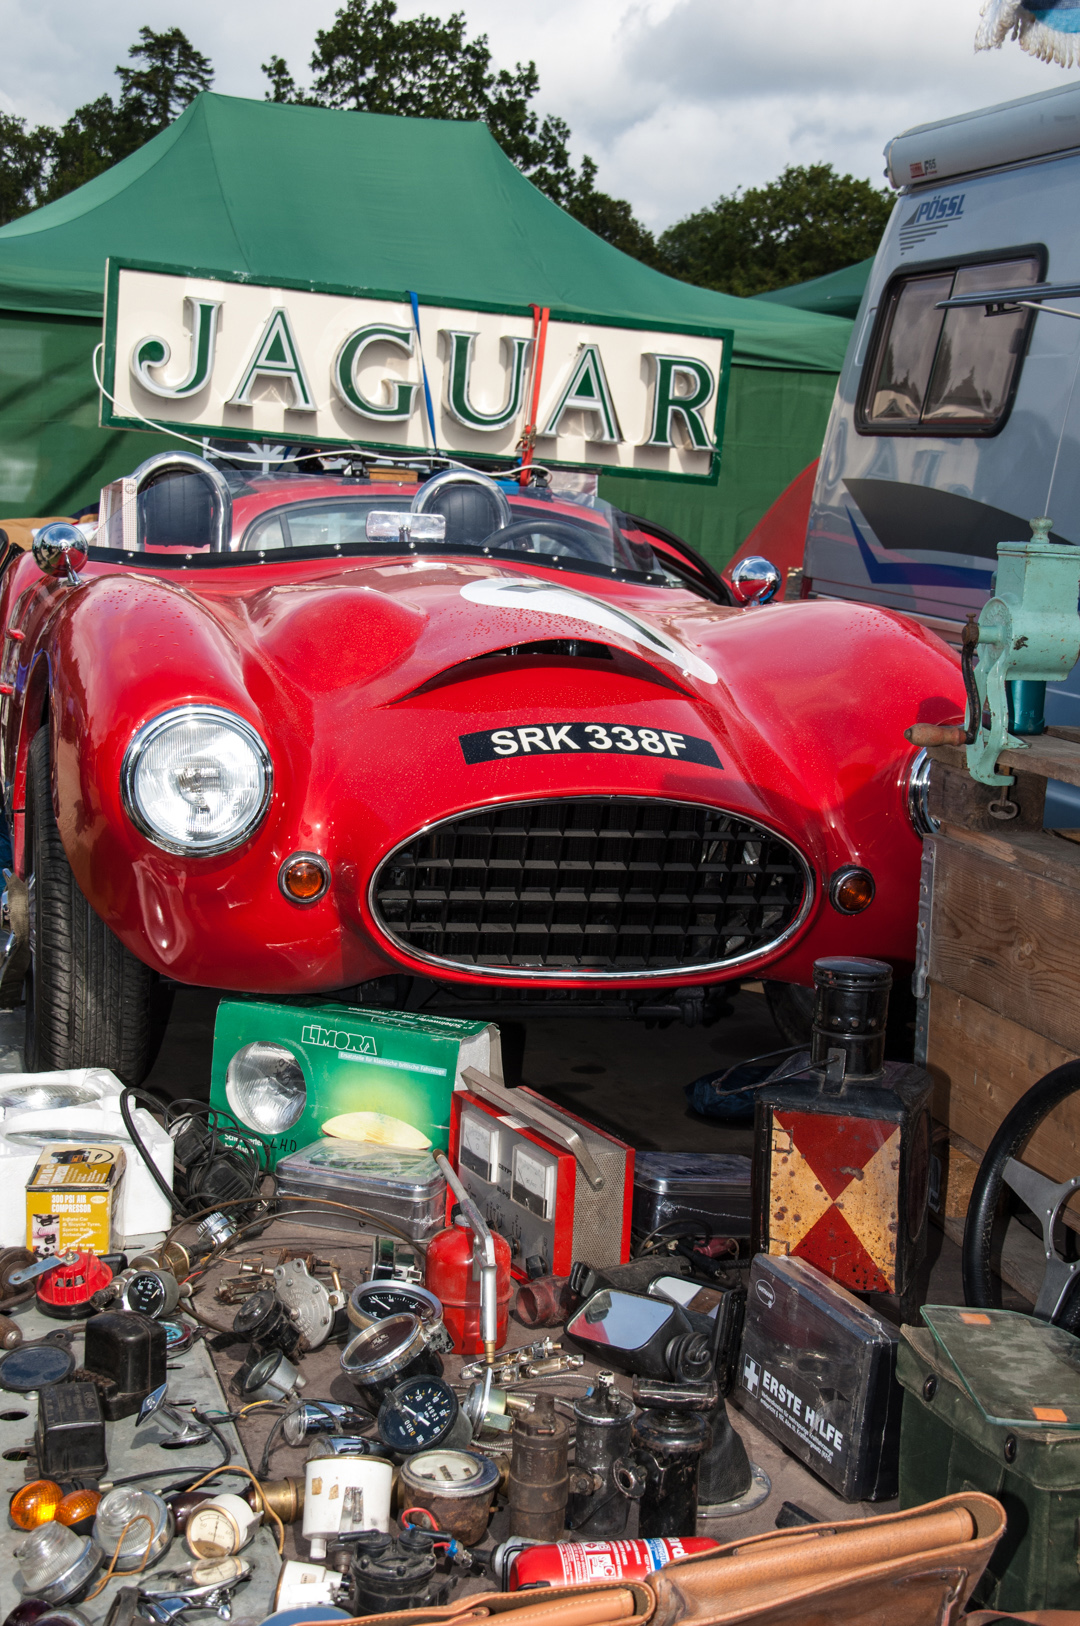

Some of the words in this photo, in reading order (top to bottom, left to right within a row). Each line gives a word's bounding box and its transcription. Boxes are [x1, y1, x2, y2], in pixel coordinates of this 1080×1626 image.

[916, 194, 966, 224] PÖSSL
[130, 296, 718, 453] JAGUAR
[490, 725, 581, 755] SRK
[584, 725, 687, 756] 338F
[301, 1024, 378, 1056] LIMORA
[51, 1194, 63, 1204] 300
[64, 1194, 75, 1204] PSI
[76, 1194, 87, 1204] AIR
[51, 1204, 92, 1213] COMPRESSOR
[762, 1369, 802, 1418] ERSTE
